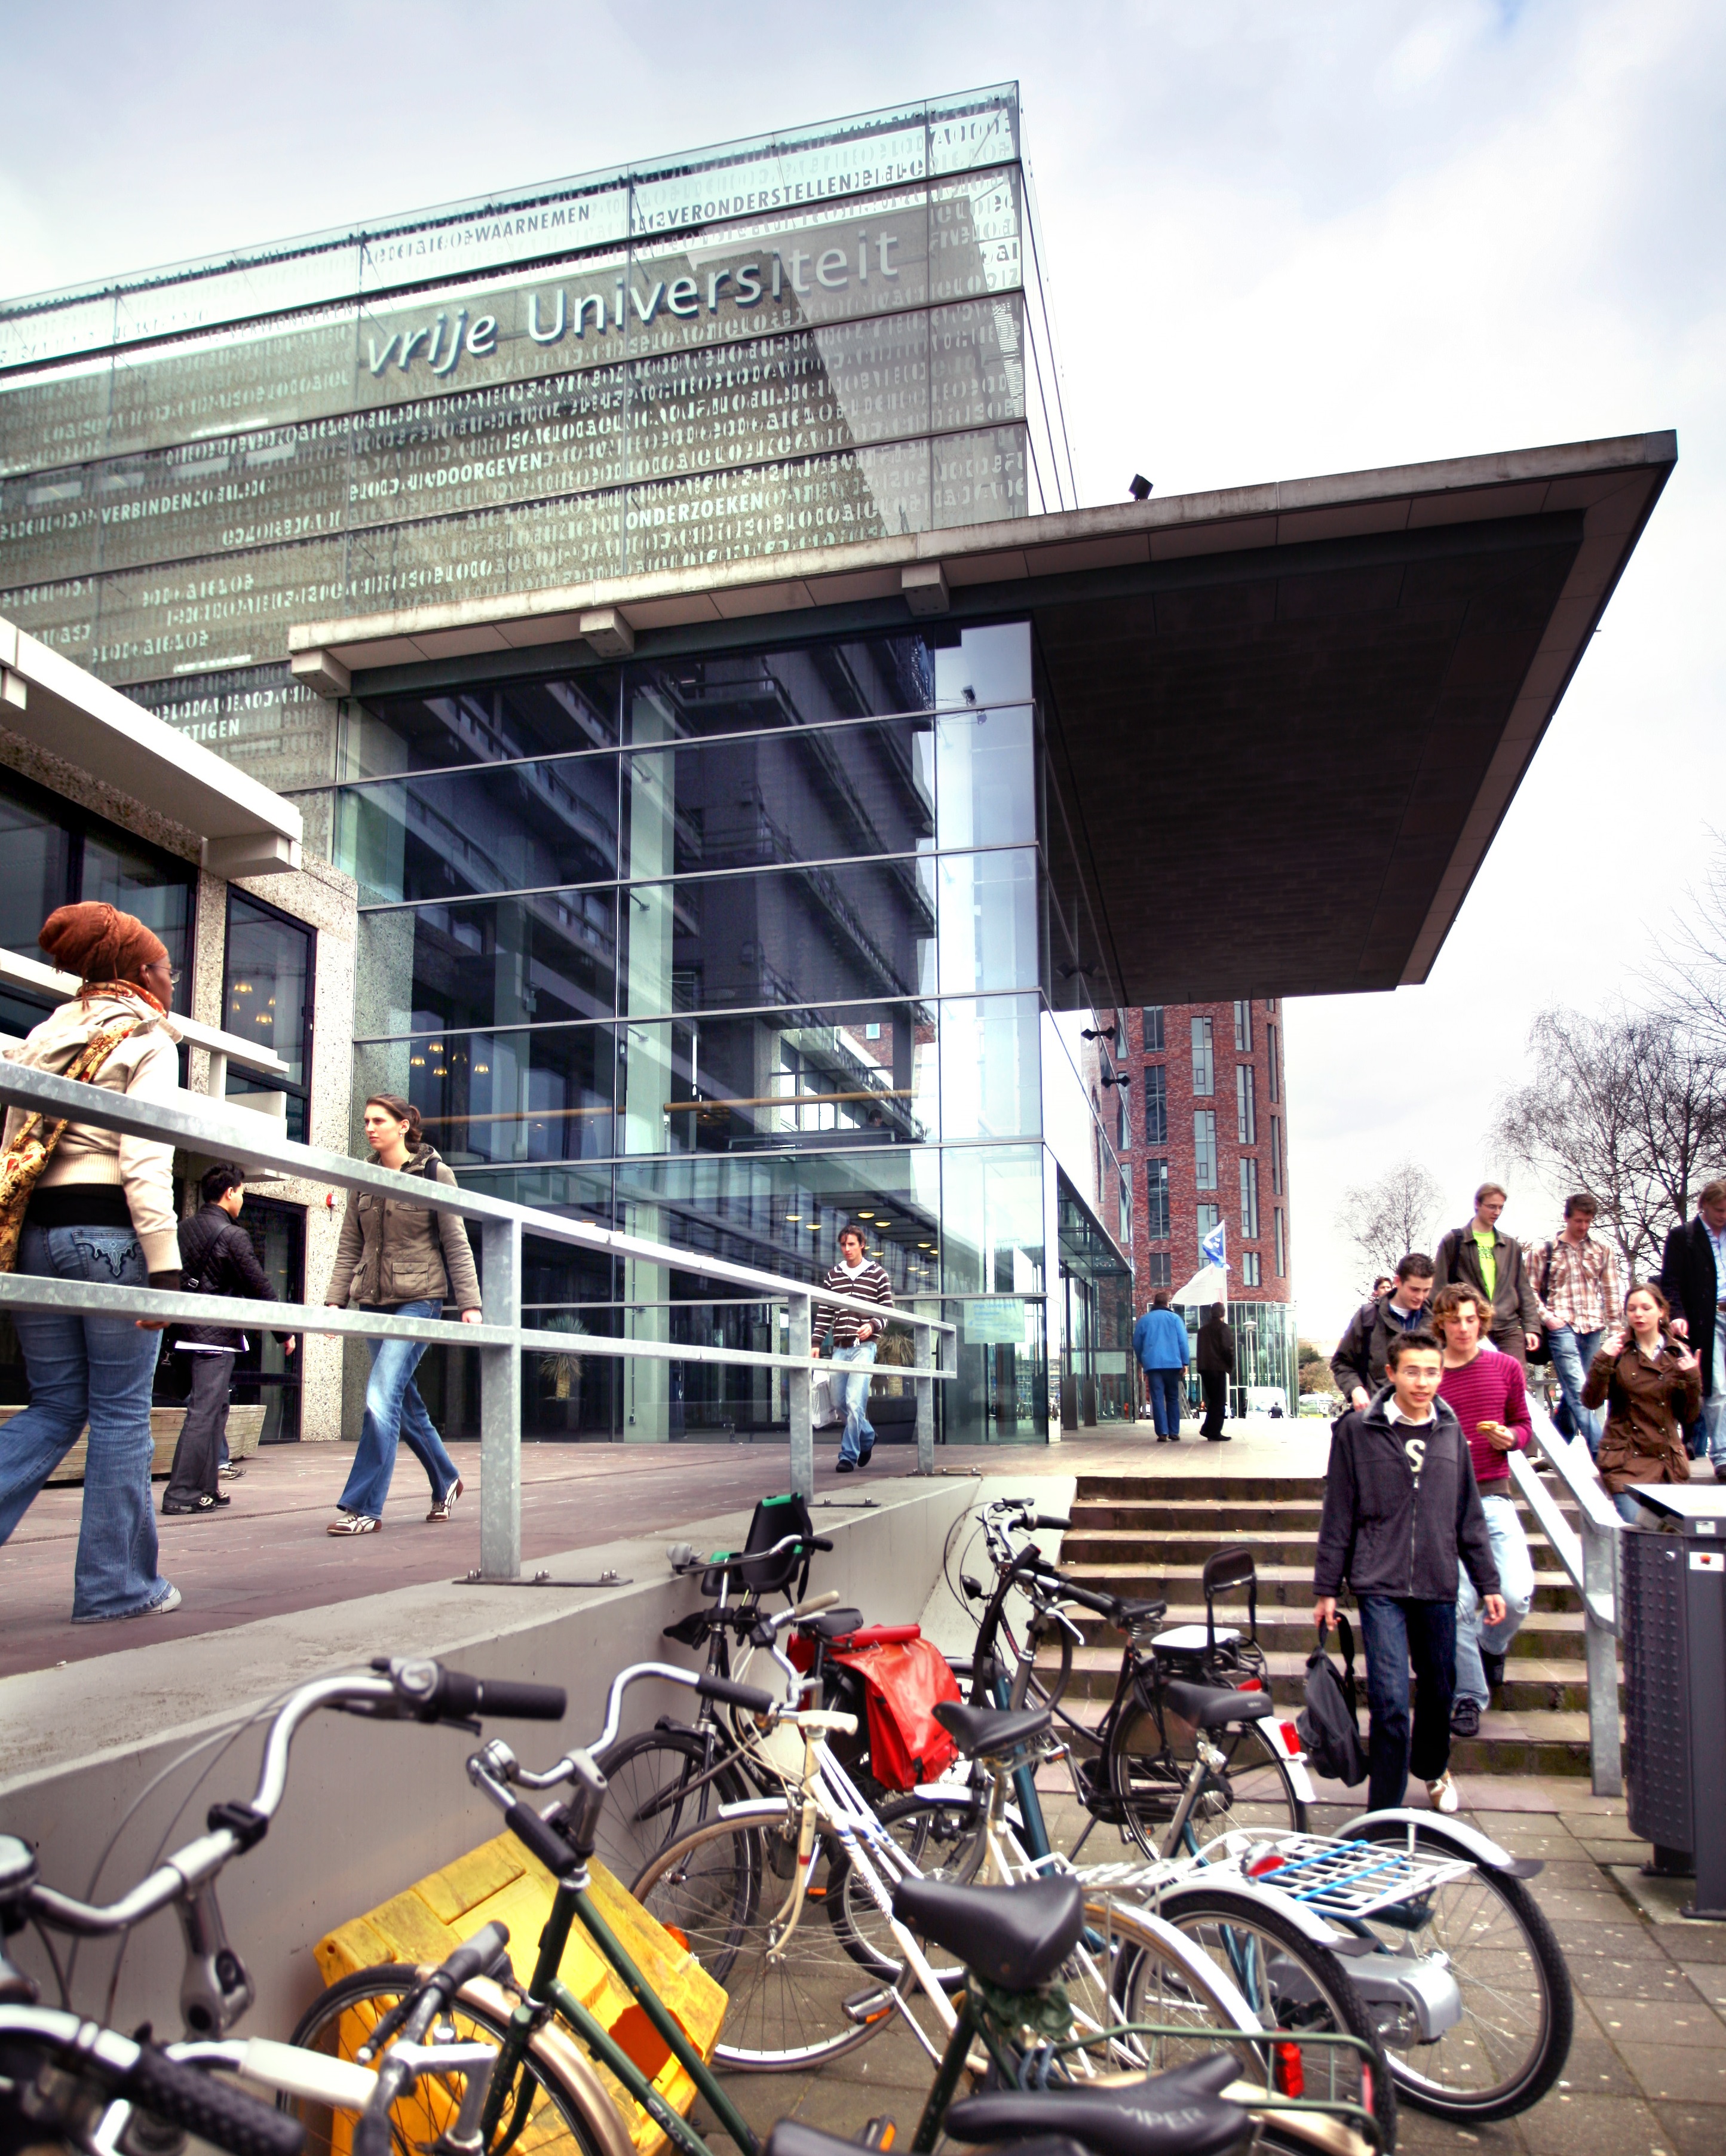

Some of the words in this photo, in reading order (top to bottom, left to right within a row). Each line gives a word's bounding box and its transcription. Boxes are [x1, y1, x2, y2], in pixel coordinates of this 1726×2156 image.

[668, 174, 851, 225] VERONDERSTELLEN
[475, 204, 589, 242] WAARNEMEN
[229, 300, 354, 339] VERWONDEREN
[368, 308, 496, 375] vrije
[528, 230, 898, 342] Universiteit
[436, 452, 542, 487] DOORGEVEN
[102, 492, 192, 524] VERBINDEN
[626, 491, 763, 530] ONDERZOEKEN
[174, 718, 240, 741] STIGEN
[861, 1872, 893, 1924] HERCULES
[1117, 2104, 1205, 2131] VIPER
